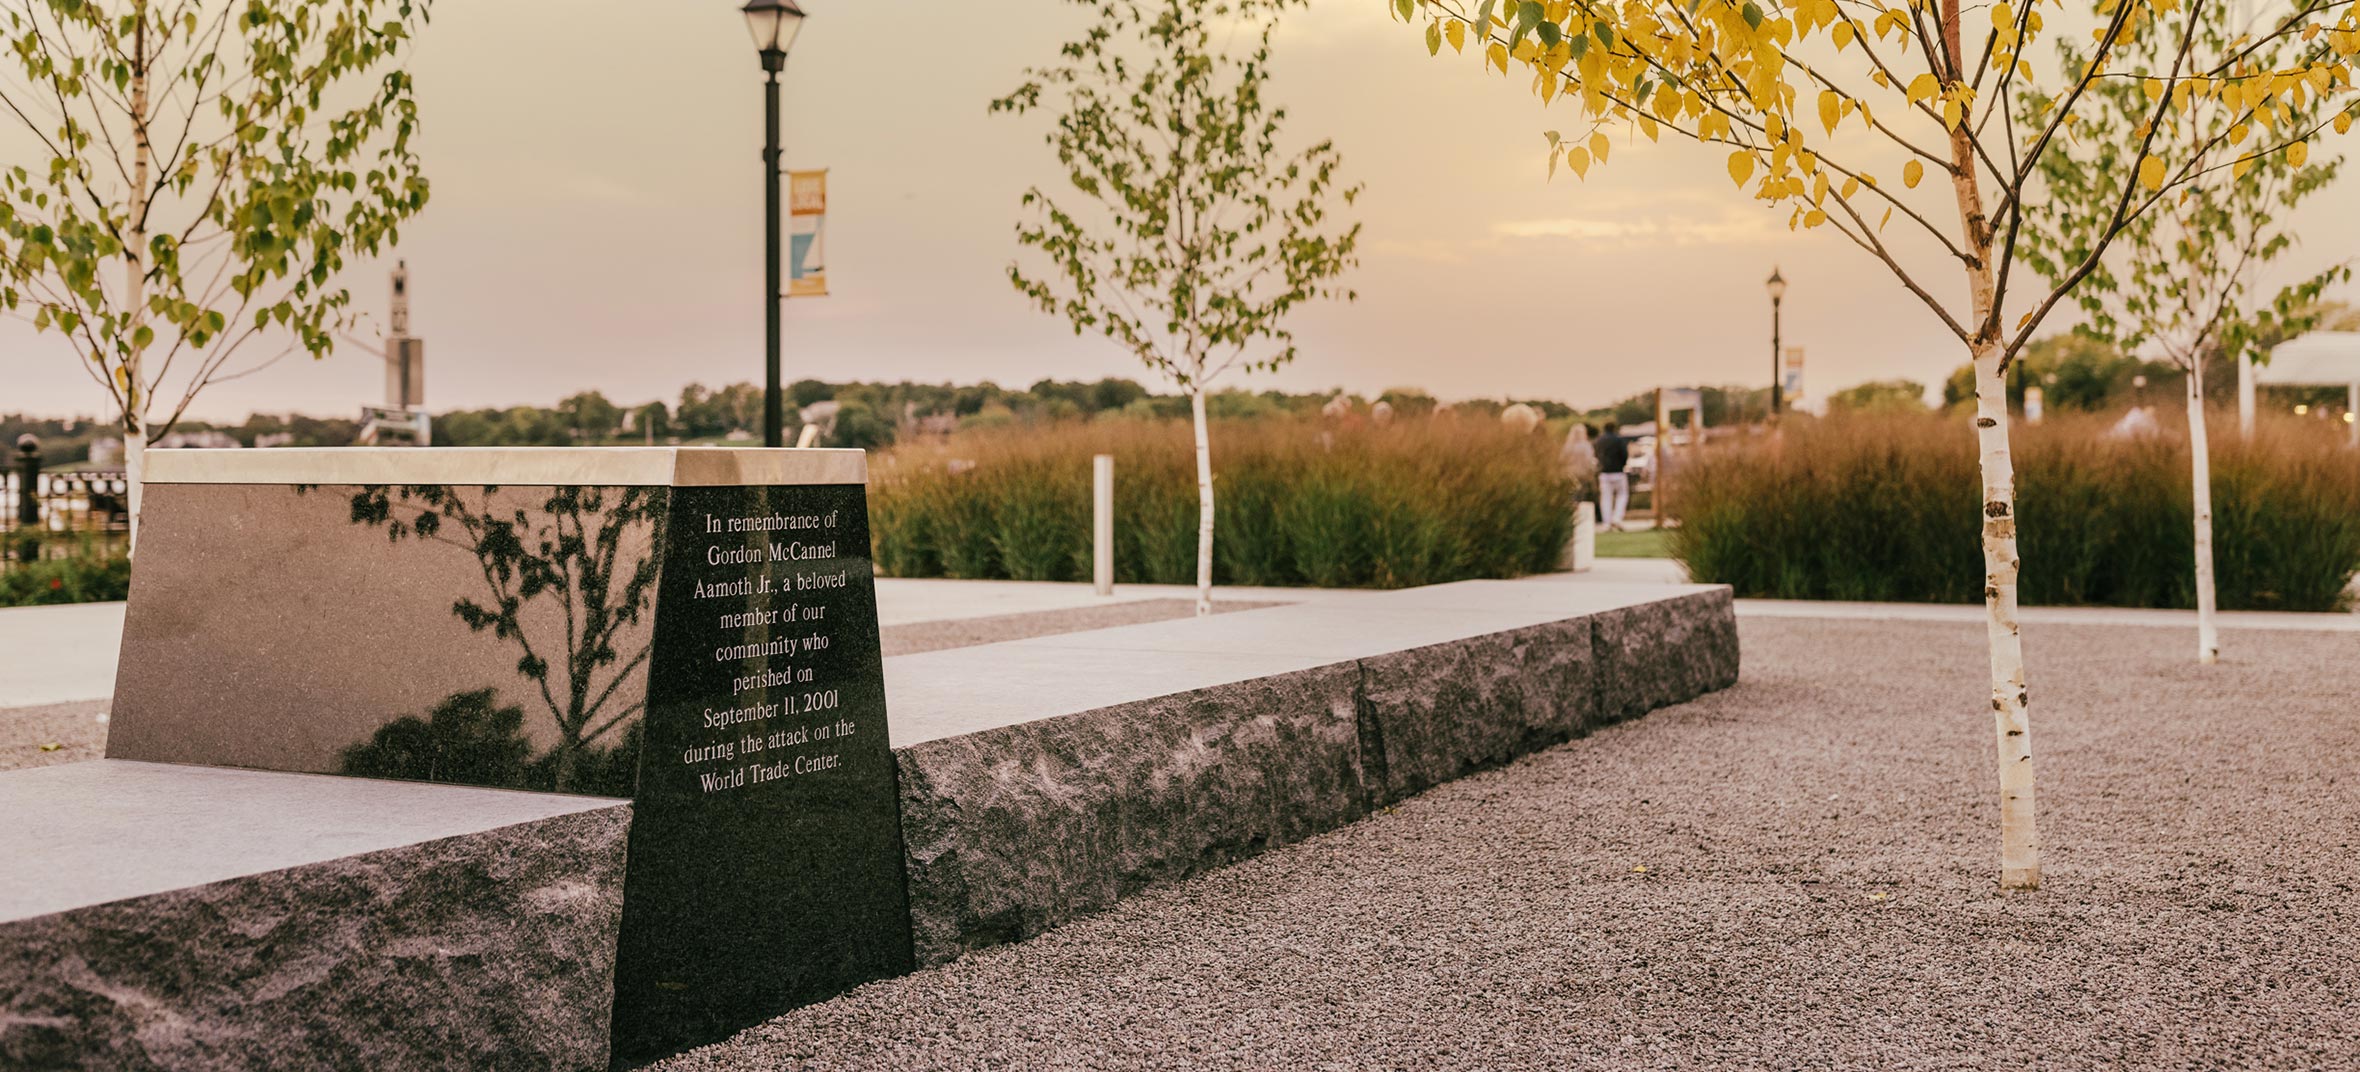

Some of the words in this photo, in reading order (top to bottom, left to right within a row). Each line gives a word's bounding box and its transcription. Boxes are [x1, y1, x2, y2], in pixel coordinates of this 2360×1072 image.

[706, 513, 722, 533] In
[727, 511, 820, 533] remembrance
[824, 510, 839, 529] of
[707, 545, 762, 566] Gordon
[768, 541, 836, 562] McCannel
[693, 577, 753, 599] Aamoth
[756, 574, 778, 595] Jr.,
[783, 577, 792, 592] a
[797, 570, 846, 591] beloved
[720, 608, 779, 629] member
[783, 603, 799, 623] of
[802, 605, 826, 621] our
[715, 635, 798, 662] community
[802, 632, 829, 651] who
[733, 666, 792, 696] perished
[796, 667, 814, 683] on
[703, 702, 779, 730] September
[784, 696, 799, 715] 11,
[803, 689, 839, 713] 2001
[683, 740, 735, 765] during
[740, 734, 764, 754] the
[768, 726, 809, 749] attack
[814, 725, 830, 741] on
[835, 718, 856, 737] the
[700, 768, 745, 793] World
[750, 760, 790, 784] Trade
[794, 753, 842, 775] Center.
